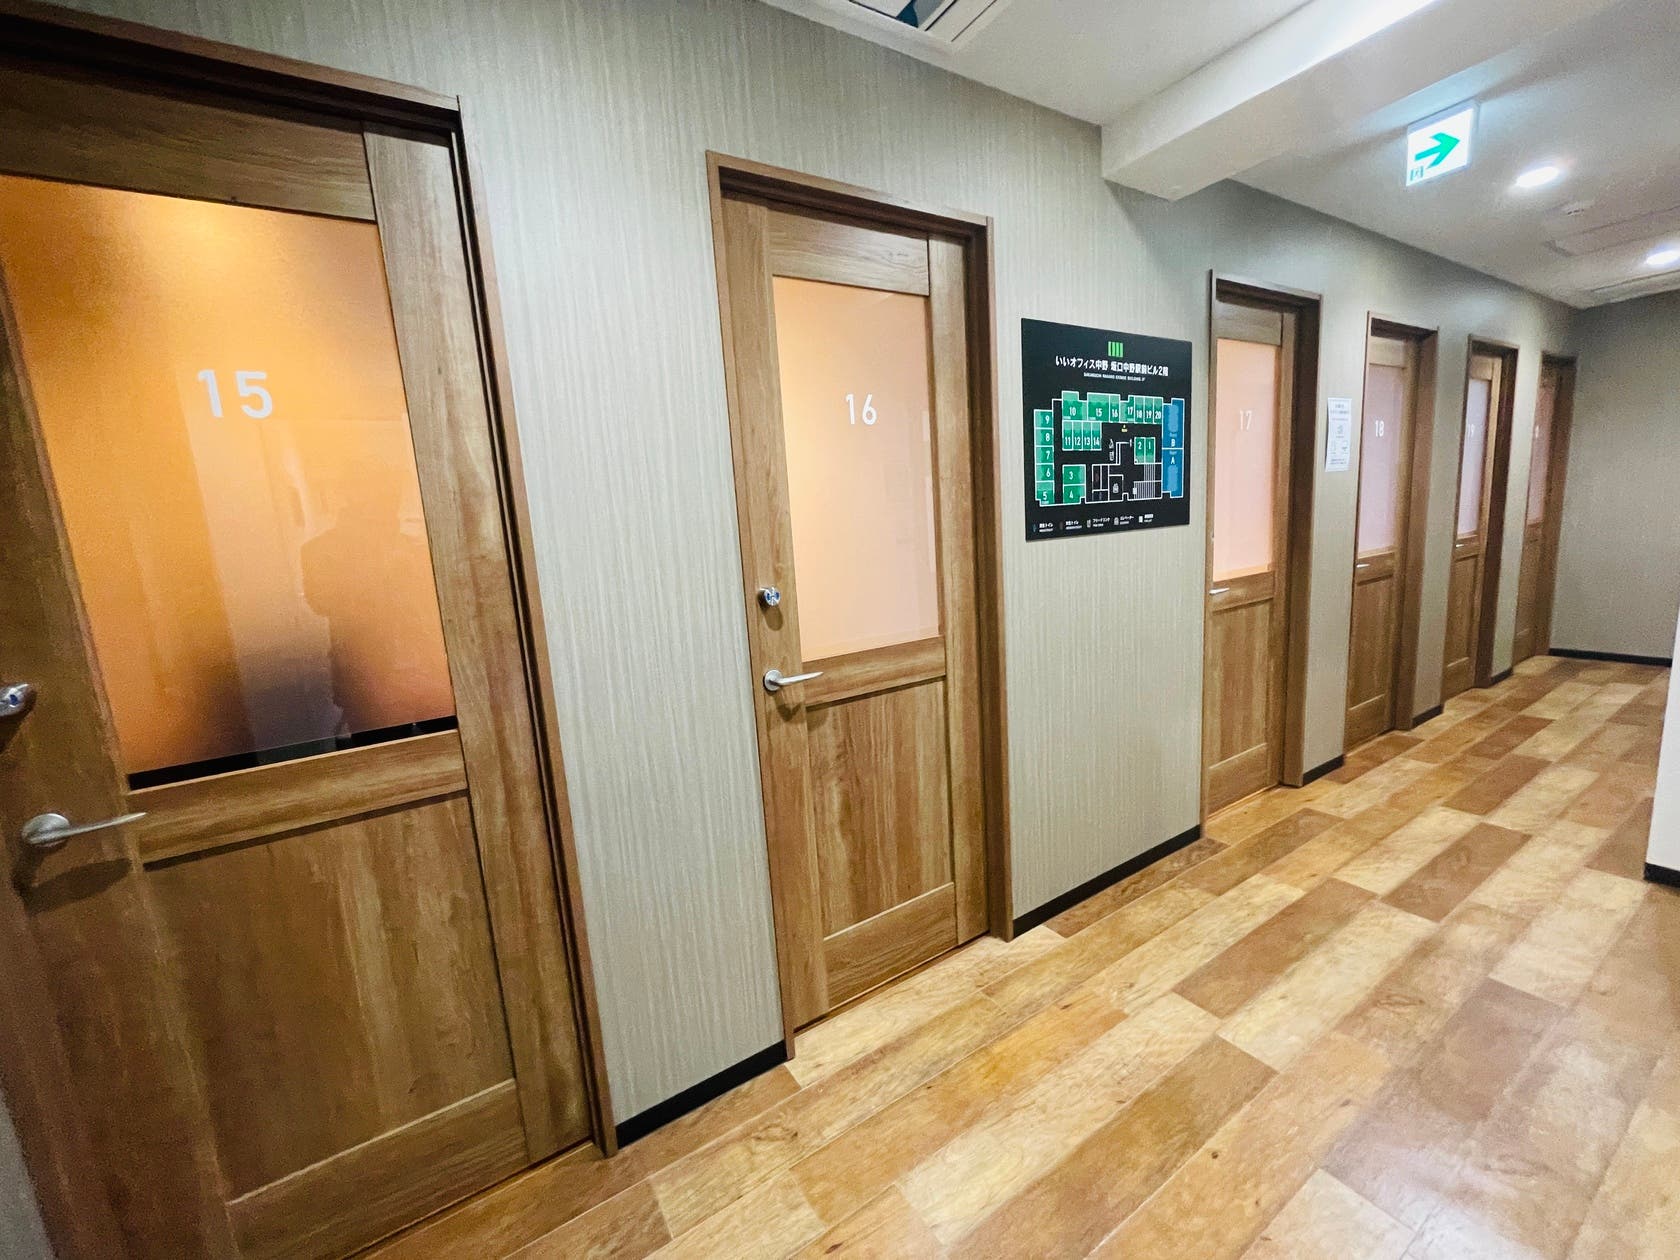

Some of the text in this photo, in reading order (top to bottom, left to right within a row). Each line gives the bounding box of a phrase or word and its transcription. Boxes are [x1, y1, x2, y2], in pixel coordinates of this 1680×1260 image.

[1055, 355, 1108, 371] いいオフィス中野
[197, 369, 273, 419] 15
[845, 393, 877, 425] 16
[1095, 407, 1103, 417] 15
[1111, 408, 1118, 418] 16
[1127, 406, 1133, 416] 17
[1145, 410, 1152, 419] 19
[1154, 410, 1161, 419] 20
[1045, 415, 1050, 425] 9
[1239, 410, 1253, 431] 17
[1375, 420, 1385, 438] 18
[1045, 432, 1051, 442] 8
[1064, 436, 1071, 446] 11
[1074, 436, 1081, 446] 12
[1084, 437, 1091, 446] 13
[1093, 436, 1100, 446] 14
[1137, 441, 1142, 450] 2
[1171, 438, 1176, 447] B
[1045, 450, 1051, 460] 7
[1170, 456, 1175, 465] A
[1046, 468, 1051, 477] 6
[1069, 471, 1074, 480] 3
[1042, 491, 1047, 501] 5
[1069, 490, 1074, 499] 4
